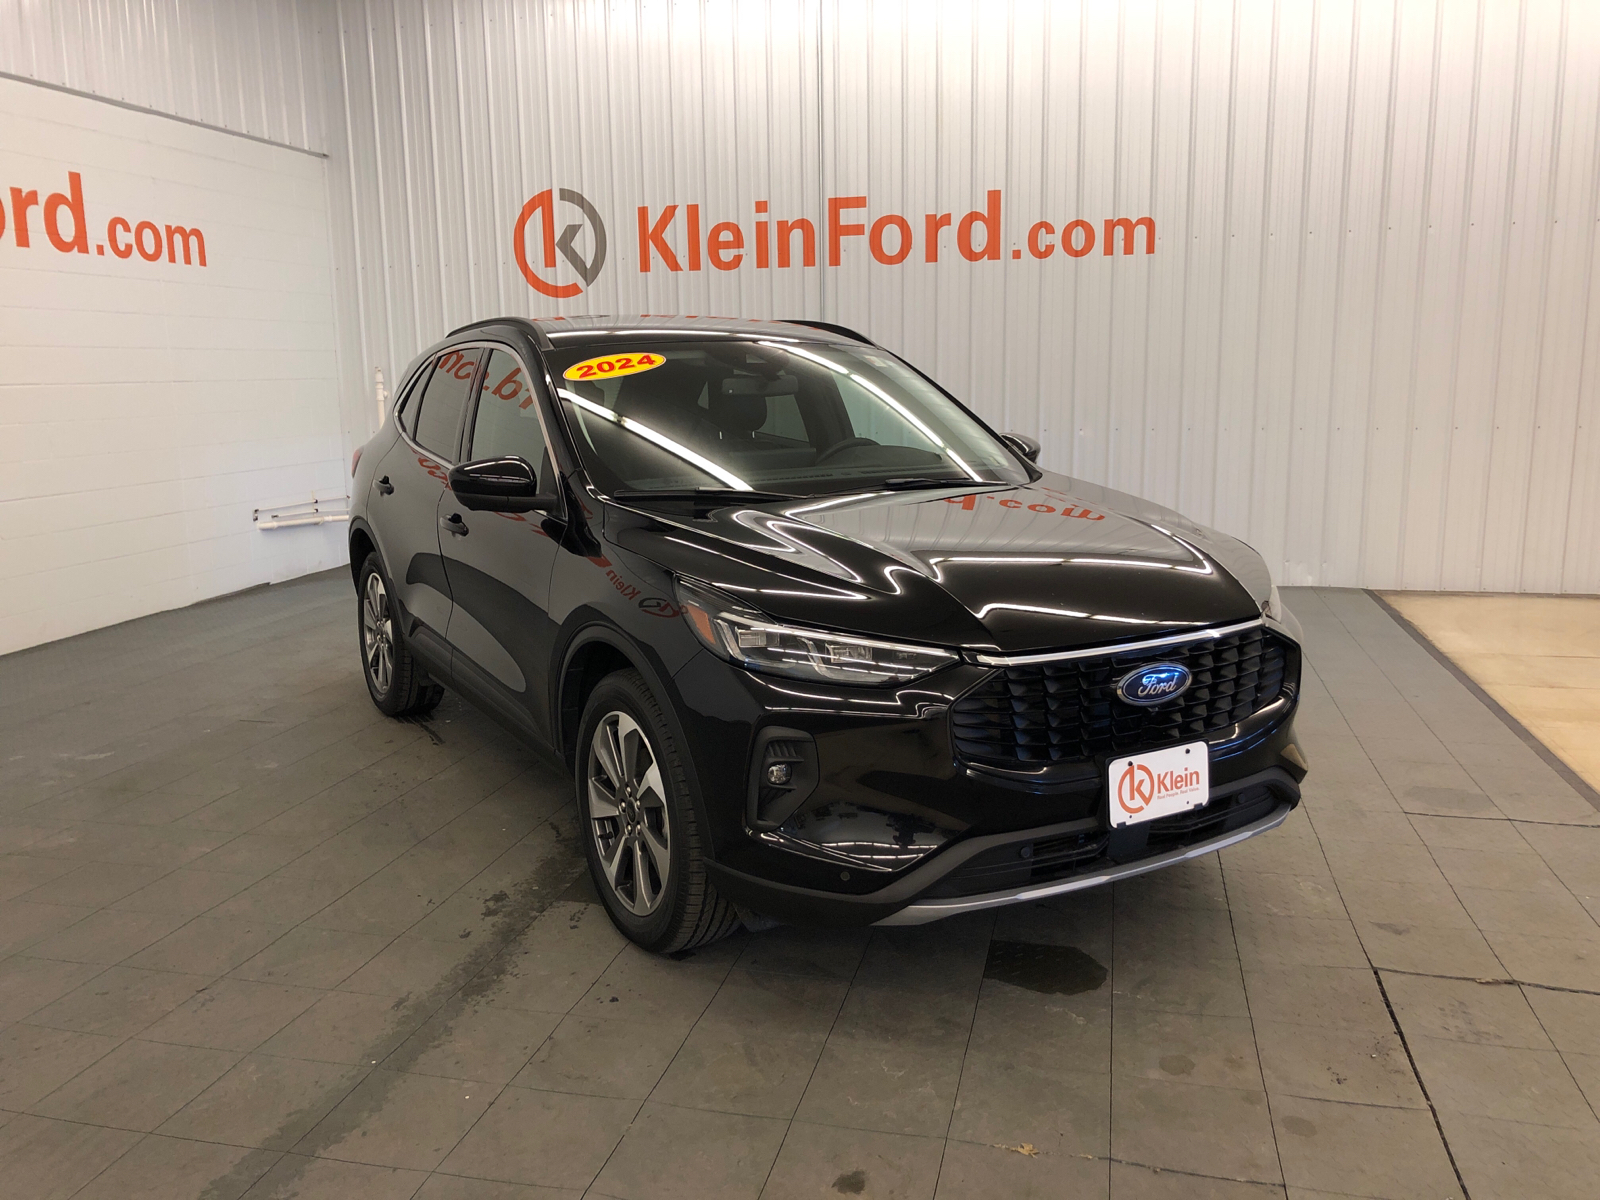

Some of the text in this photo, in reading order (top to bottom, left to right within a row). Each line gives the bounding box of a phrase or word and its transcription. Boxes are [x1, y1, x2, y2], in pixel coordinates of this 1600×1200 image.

[0, 171, 207, 268] rd.com
[637, 187, 1157, 274] KleinFord.com
[575, 354, 656, 379] 2024
[1137, 672, 1180, 697] Ford
[1156, 767, 1200, 794] Klein
